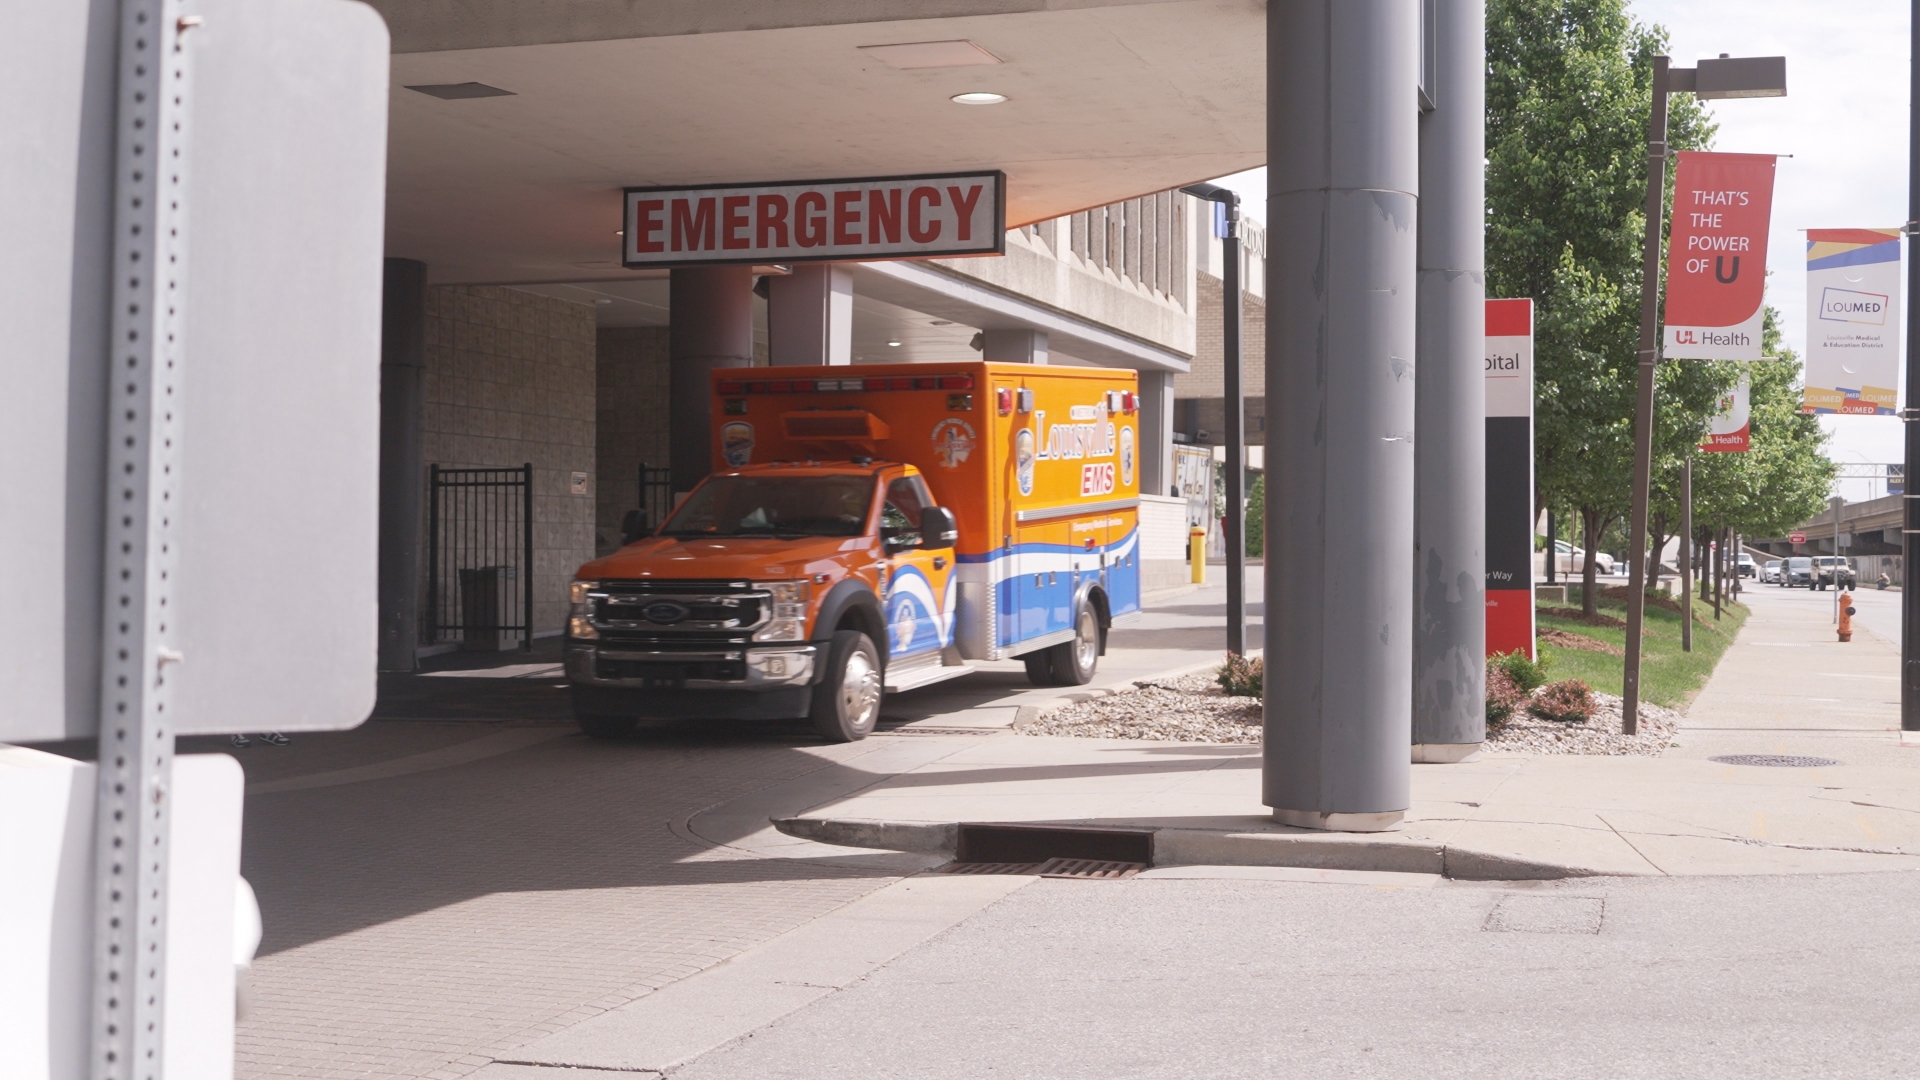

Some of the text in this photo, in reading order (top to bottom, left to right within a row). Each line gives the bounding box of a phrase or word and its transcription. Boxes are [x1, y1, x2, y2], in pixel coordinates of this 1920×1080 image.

[1692, 190, 1750, 206] THAT'S
[637, 184, 984, 254] EMERGENCY
[1690, 213, 1723, 228] THE
[1688, 236, 1750, 251] POWER
[1686, 256, 1740, 284] OF U
[1827, 302, 1881, 313] LOUMED
[1702, 332, 1750, 346] Health
[1035, 401, 1116, 460] Louisville
[1715, 435, 1743, 444] Health
[1082, 463, 1115, 496] EMS
[1492, 571, 1513, 582] Way
